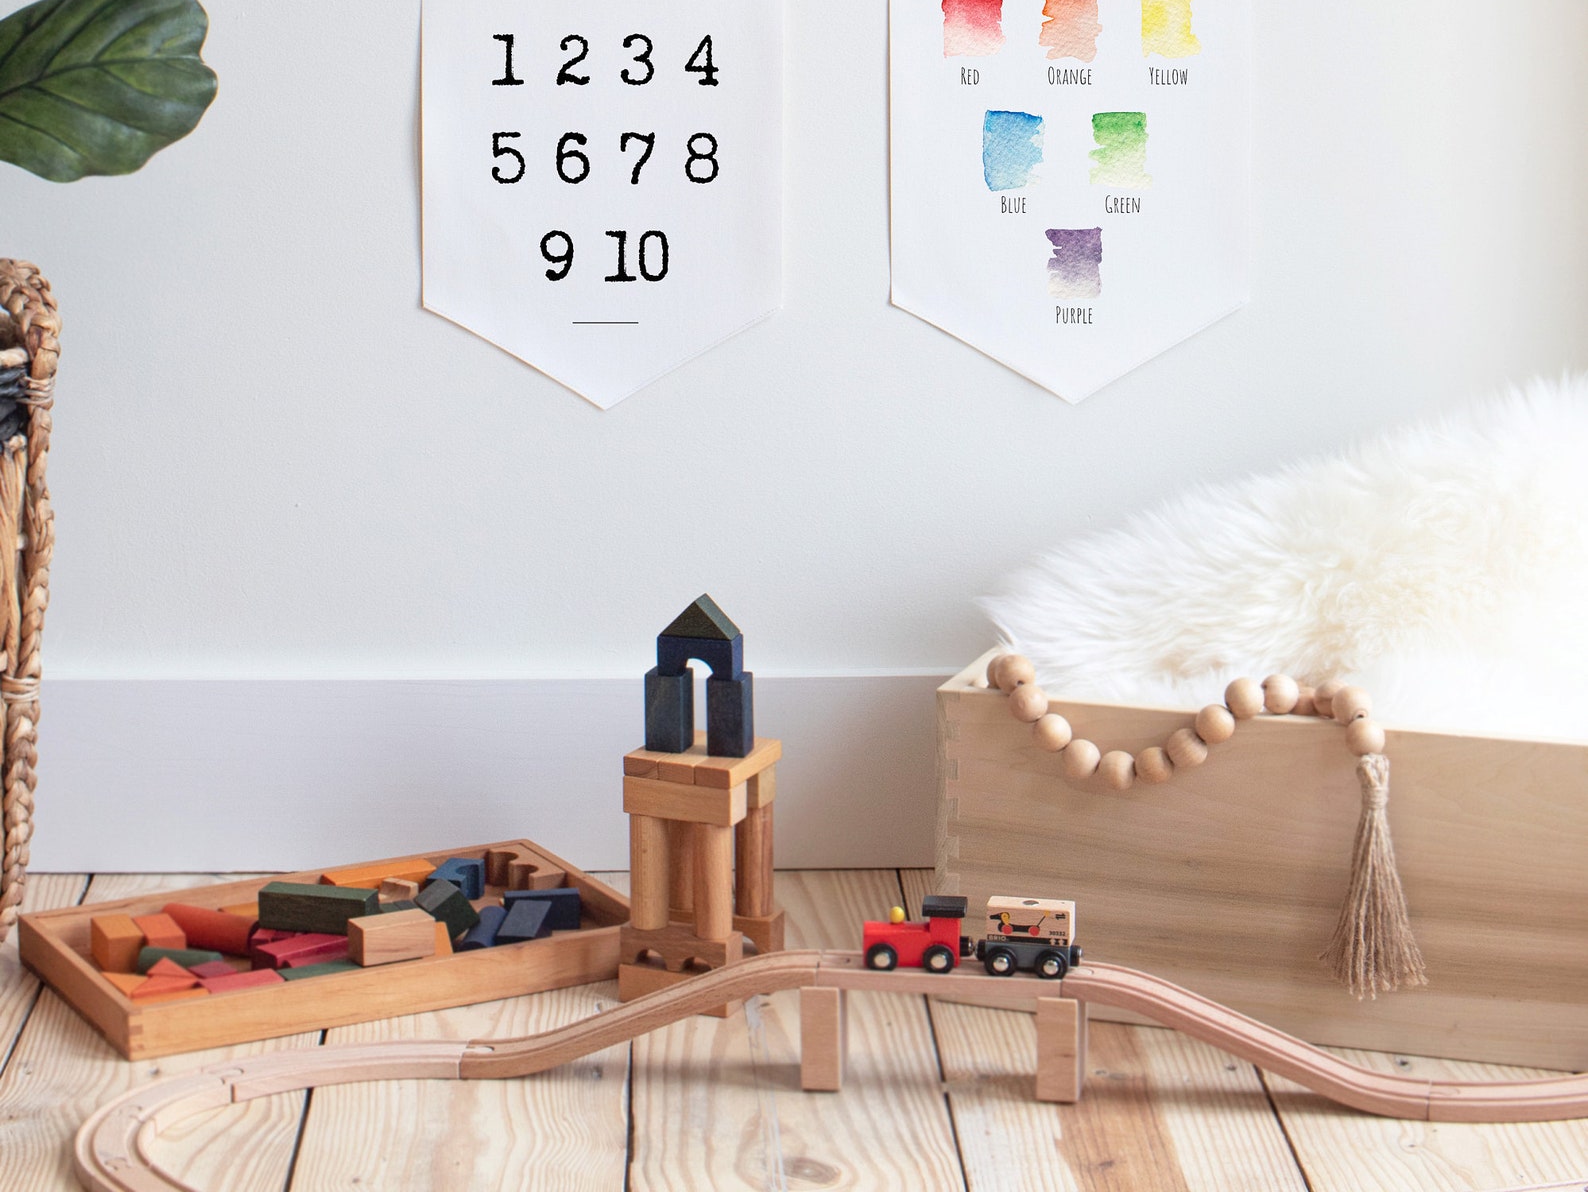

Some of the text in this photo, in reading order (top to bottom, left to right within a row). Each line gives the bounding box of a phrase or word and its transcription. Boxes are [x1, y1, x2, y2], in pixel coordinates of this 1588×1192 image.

[491, 33, 720, 87] 1 2 3 4
[960, 66, 980, 86] RED
[1047, 66, 1092, 86] ORANGE
[1148, 67, 1188, 86] YELLOW
[491, 131, 720, 185] 5 6 7 8
[1001, 195, 1027, 214] BLUE
[1105, 194, 1141, 214] GREEN
[539, 229, 670, 283] 9 10
[1055, 305, 1093, 325] PURPLE
